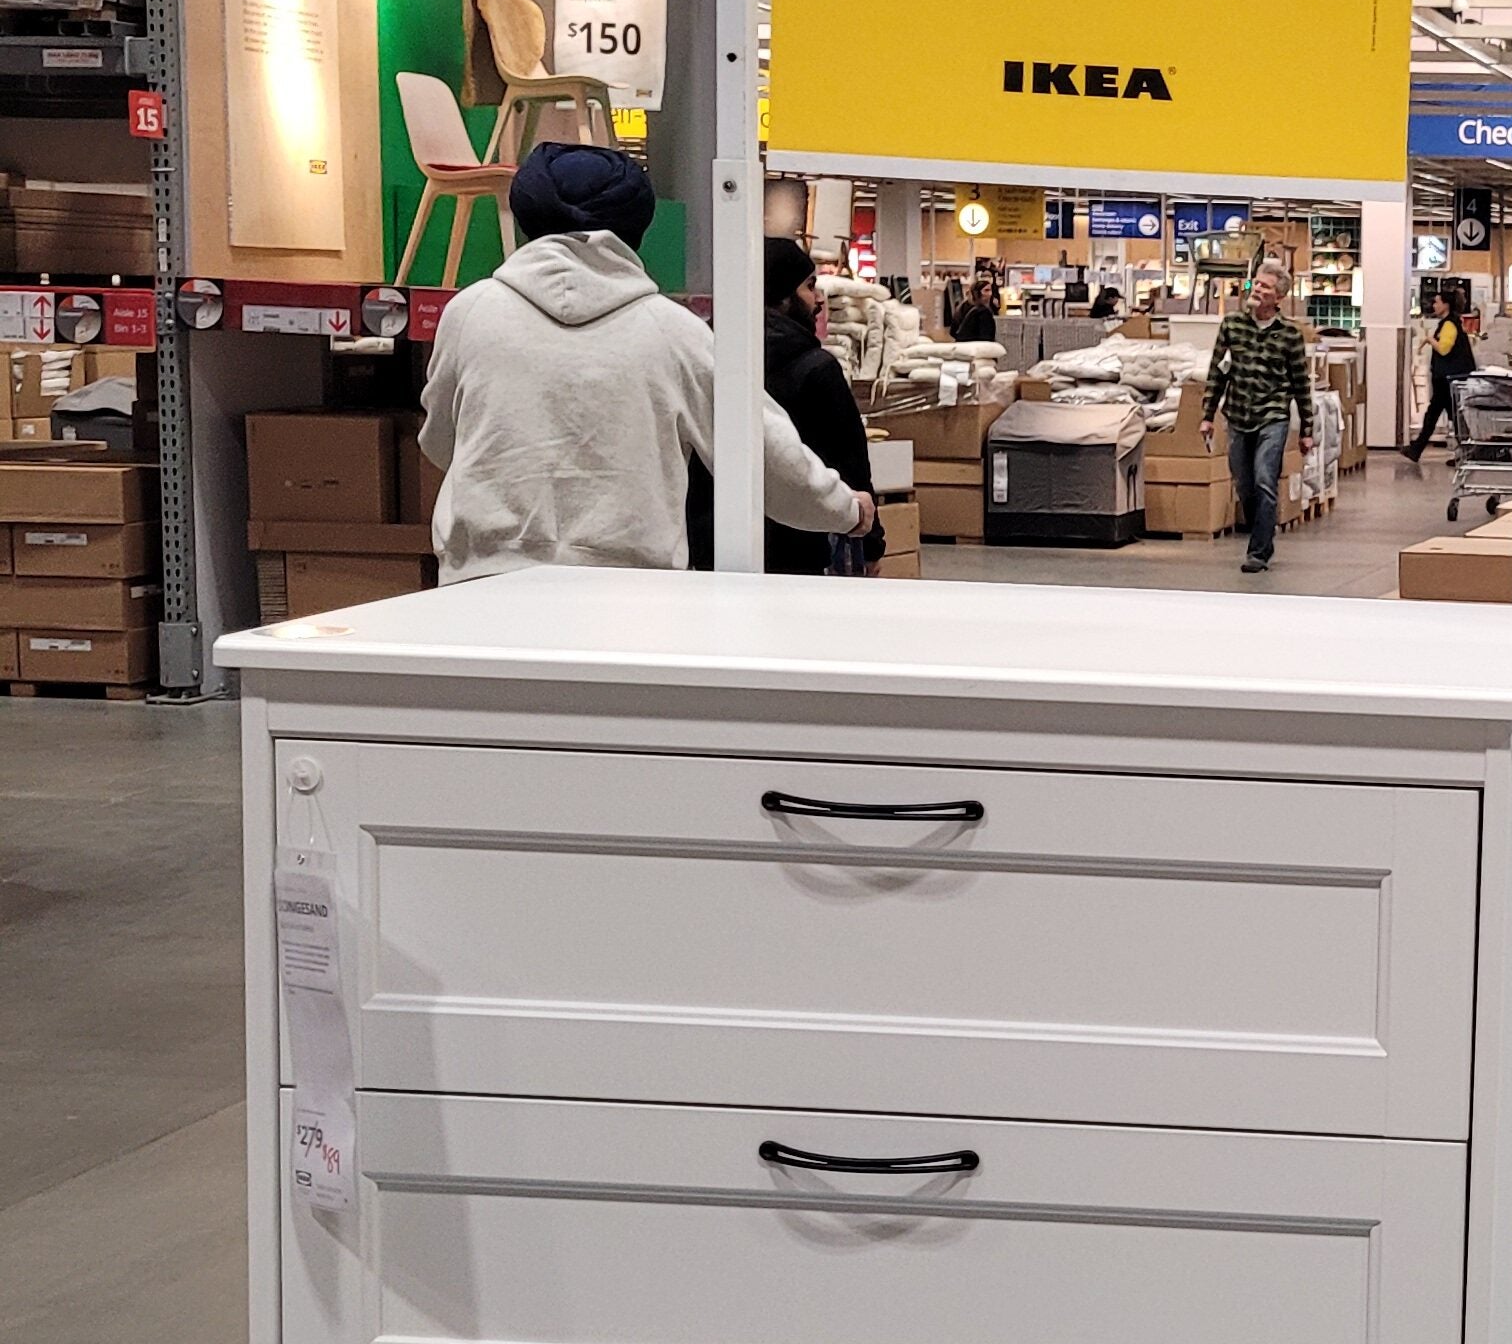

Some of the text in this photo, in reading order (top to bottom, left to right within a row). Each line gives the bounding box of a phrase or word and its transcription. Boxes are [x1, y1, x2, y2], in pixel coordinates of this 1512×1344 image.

[567, 22, 641, 55] $150
[136, 108, 160, 131] 15
[1465, 198, 1478, 214] 4
[1177, 218, 1199, 233] Exit
